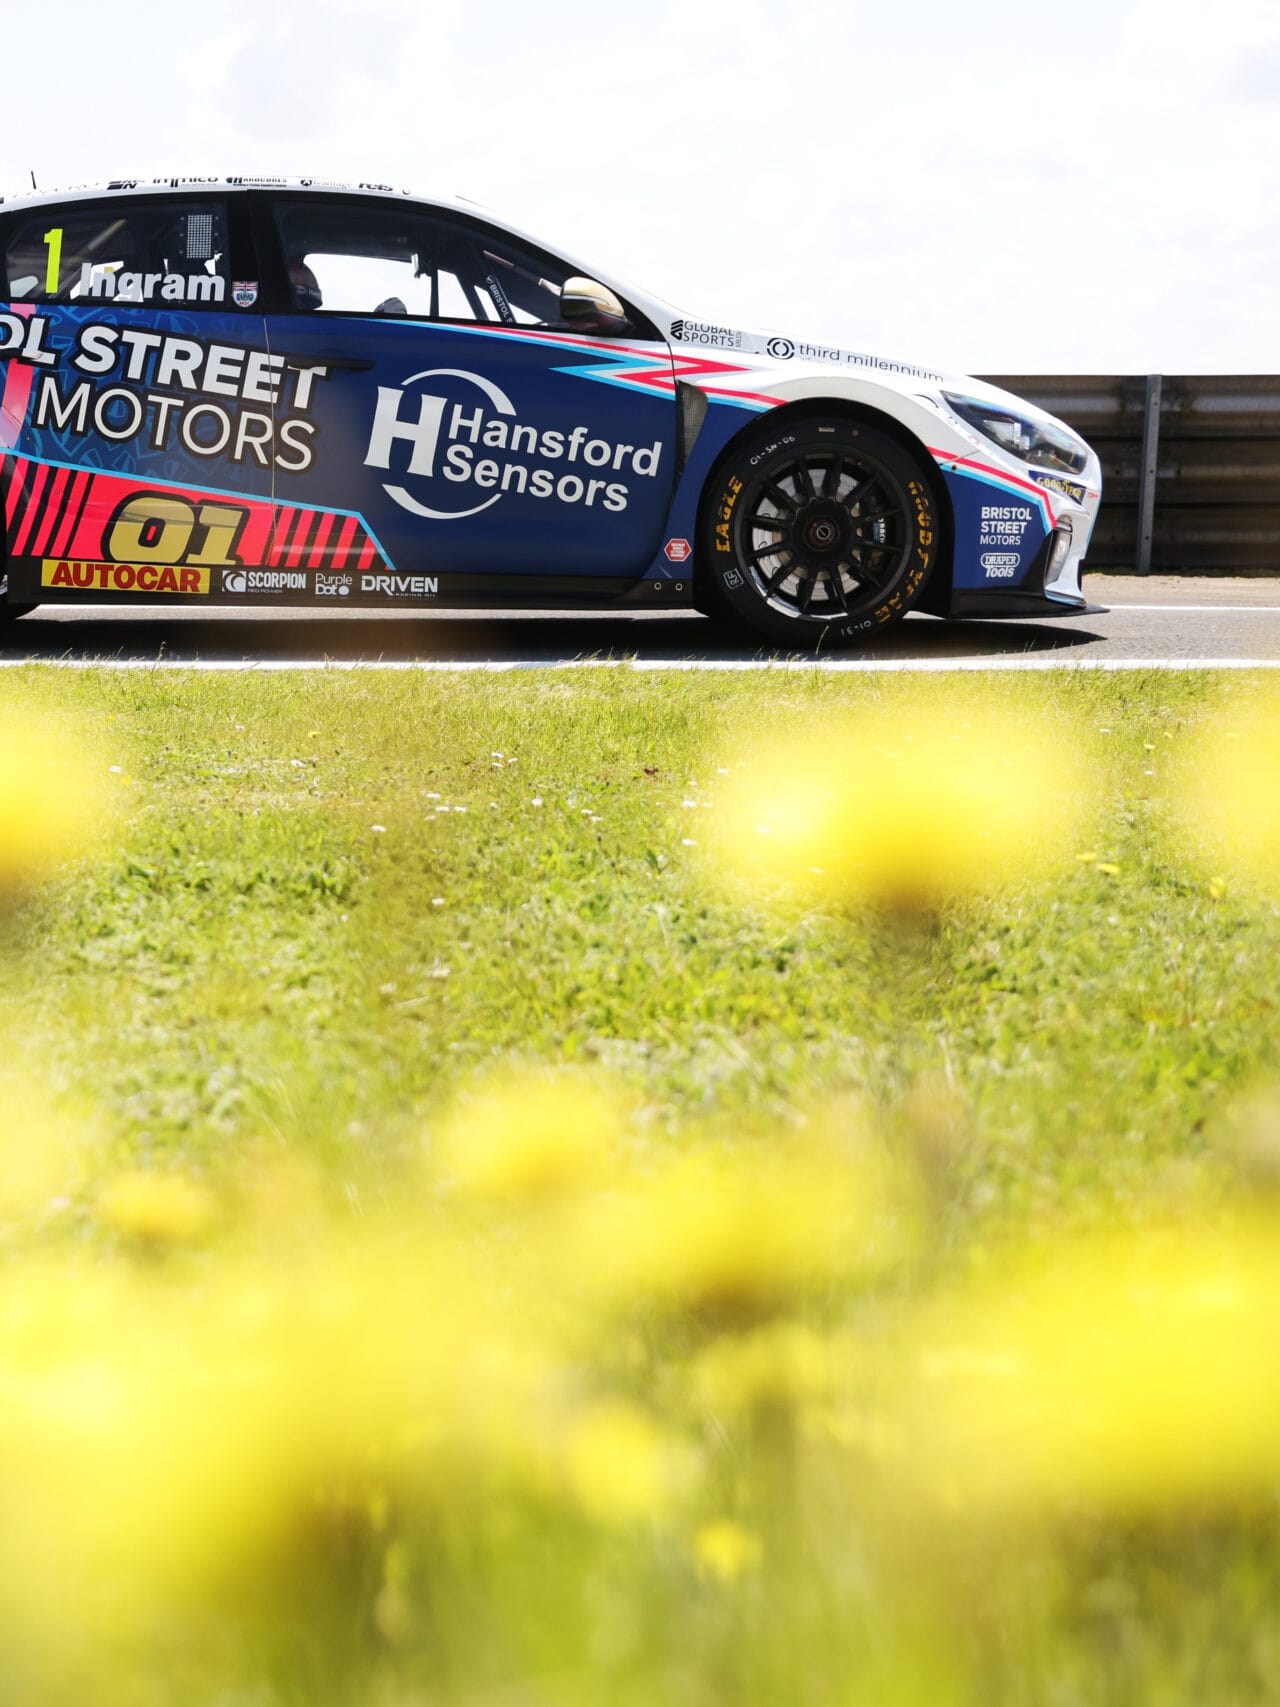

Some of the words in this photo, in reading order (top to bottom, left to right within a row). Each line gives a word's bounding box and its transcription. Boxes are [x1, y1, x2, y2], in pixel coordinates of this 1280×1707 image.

[43, 228, 64, 294] 1
[80, 262, 226, 302] Ingram
[682, 331, 734, 347] SPORTS
[684, 320, 735, 337] GLOBAL
[74, 325, 328, 410] STREET
[799, 344, 840, 361] third
[847, 354, 944, 383] millennium
[36, 376, 316, 471] MOTORS
[448, 403, 664, 477] Hansford
[442, 443, 630, 512] Sensors
[715, 475, 745, 553] EAGLE
[981, 506, 1032, 520] BRISTOL
[108, 496, 244, 566] 01
[980, 521, 1027, 534] STREET
[979, 535, 1022, 546] MOTORS
[984, 555, 1017, 566] DRAPER
[50, 561, 202, 593] AUTOCAR
[247, 571, 307, 588] SCORPION
[315, 572, 353, 587] Purple
[985, 566, 1015, 578] Tools
[315, 584, 338, 595] Dot
[361, 575, 439, 596] DRIVEN
